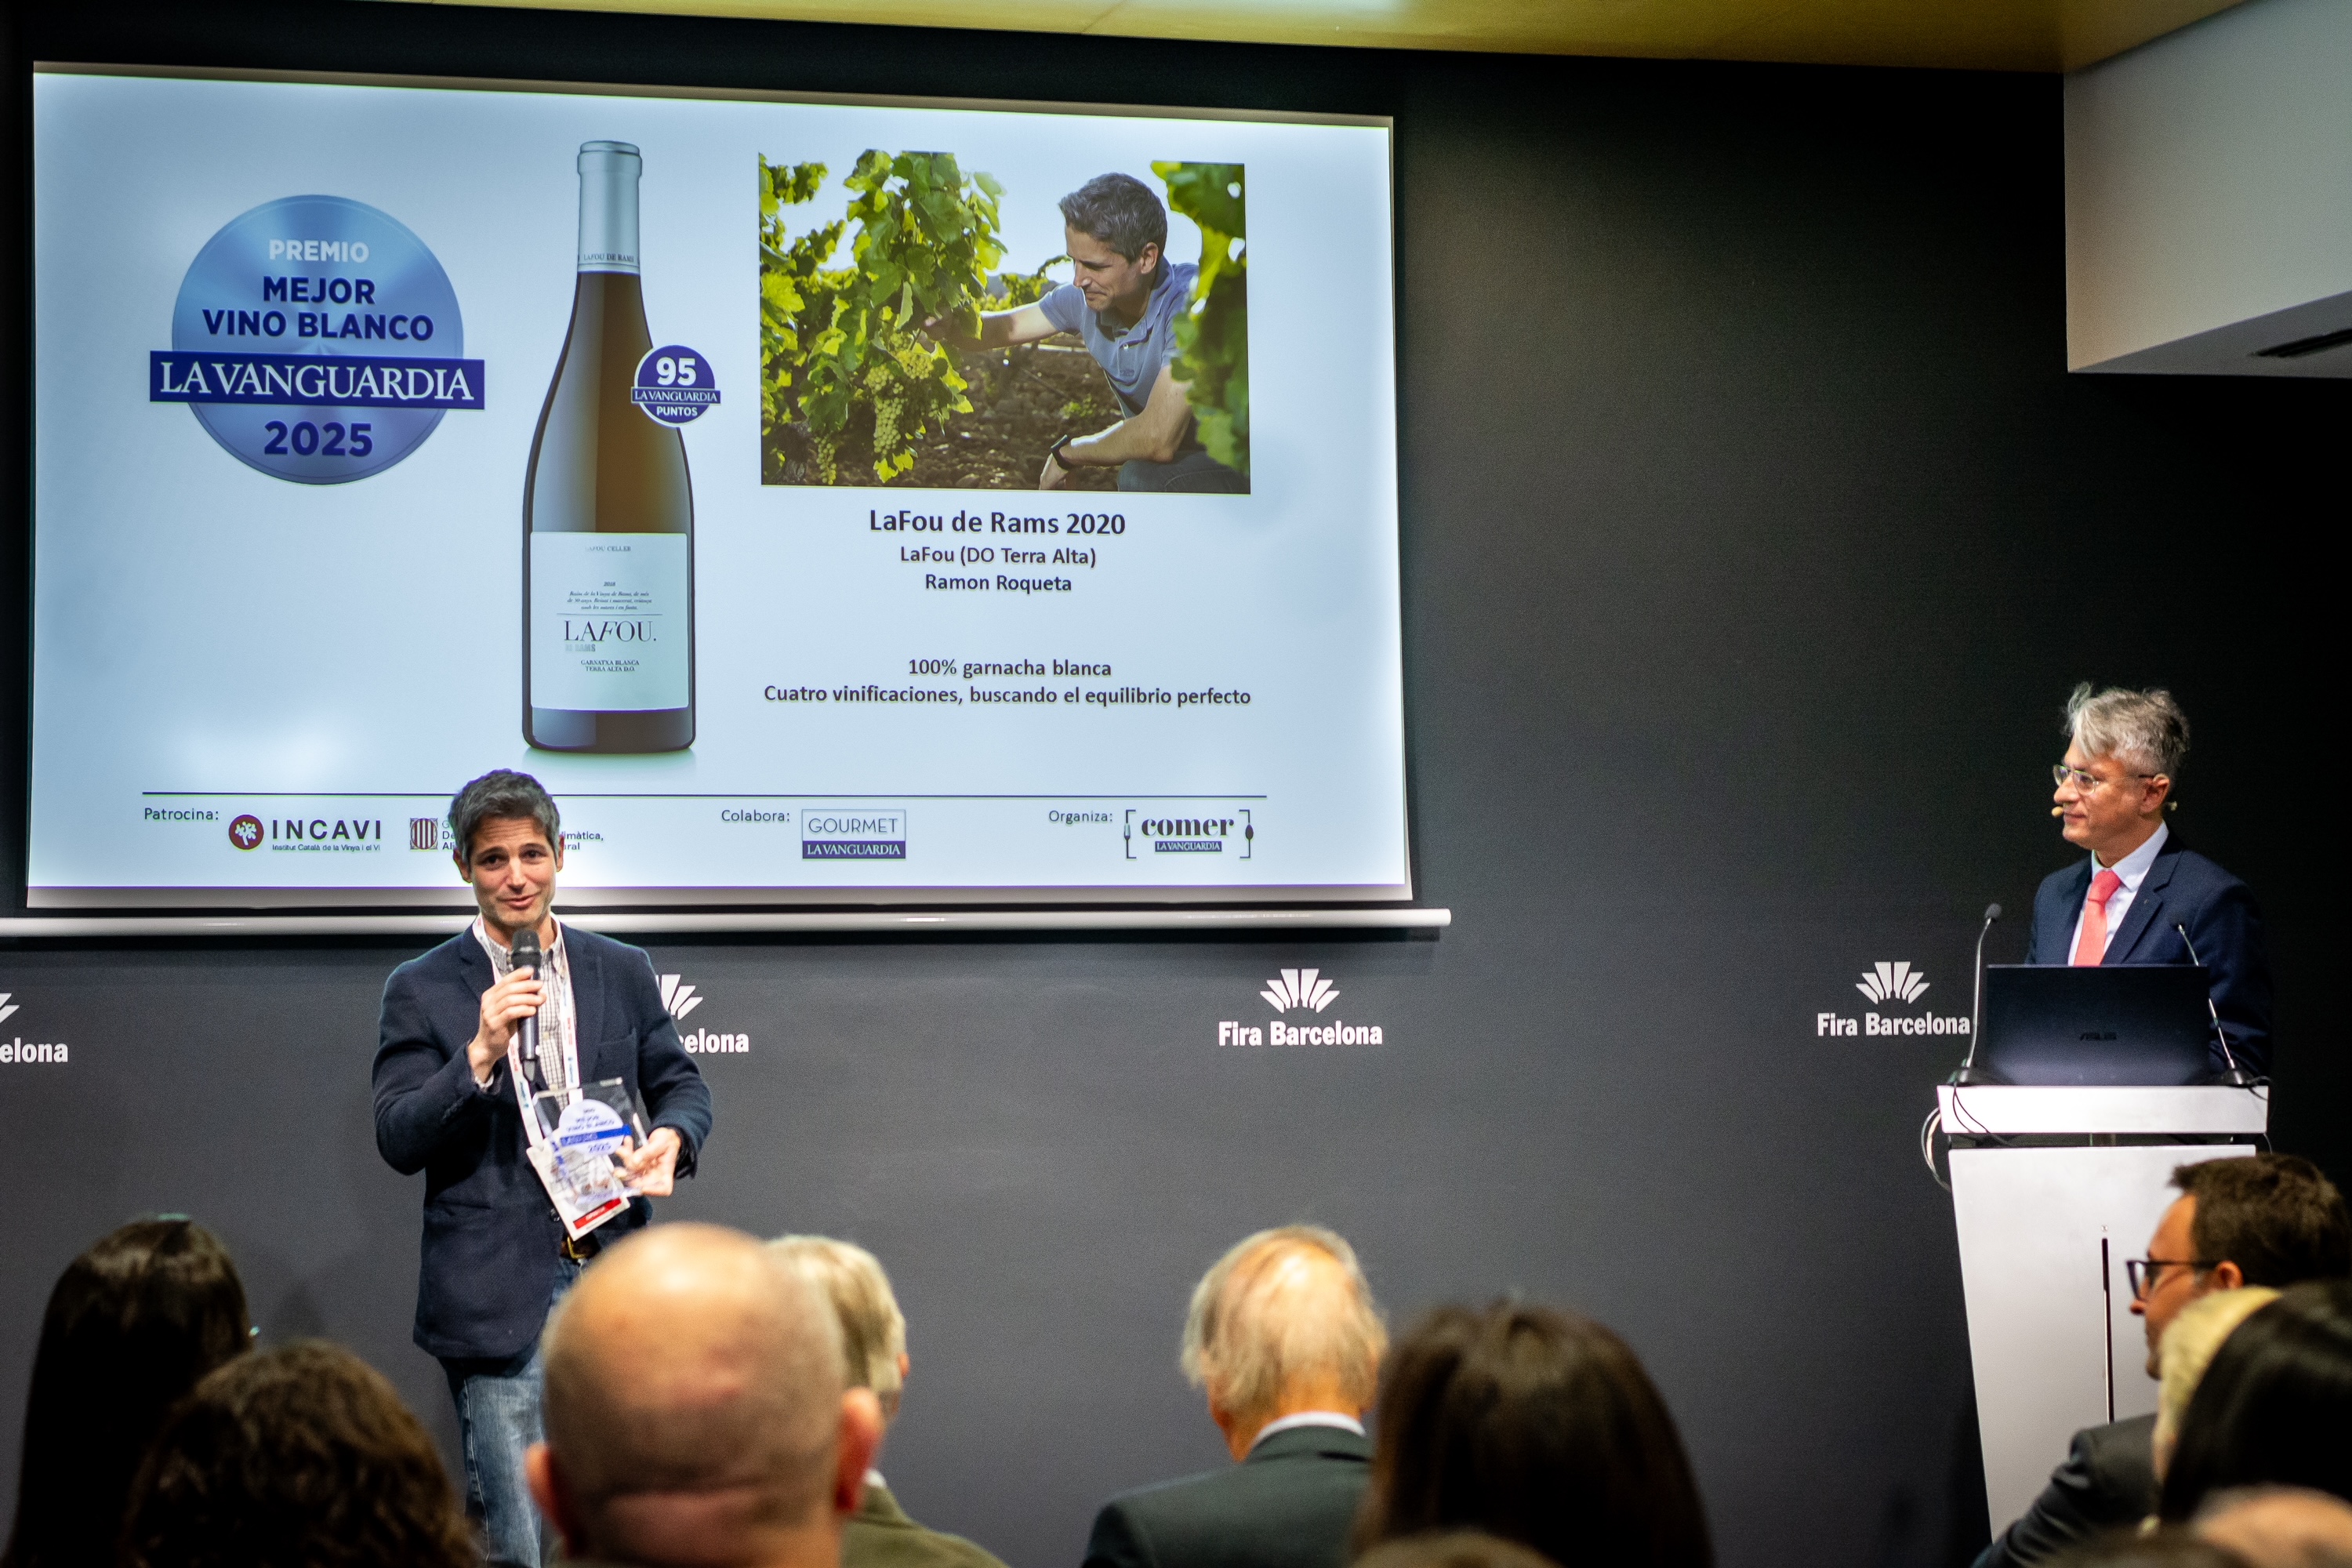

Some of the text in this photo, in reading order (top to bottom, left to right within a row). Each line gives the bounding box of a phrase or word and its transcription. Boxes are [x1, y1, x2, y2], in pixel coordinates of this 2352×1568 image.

[269, 239, 370, 263] PREMIO
[263, 276, 376, 305] MEJOR
[202, 309, 434, 341] VINO BLANCO
[656, 357, 697, 387] 95
[657, 406, 698, 416] PUNTOS
[264, 420, 373, 456] 2025
[869, 510, 1126, 535] LaFou de Rams 2020
[901, 546, 1096, 568] LaFou (DO Terra Alta)
[926, 574, 1072, 594] Ramon Roqueta
[909, 659, 1112, 679] 100% garnacha blanca
[764, 685, 1250, 707] Cuatro vinificaciones, buscando el equilibrio perfecto
[144, 808, 219, 821] Patrocina:
[721, 809, 790, 822] Colabora:
[808, 818, 898, 833] GOURMET
[1049, 810, 1113, 825] Organiza:
[273, 820, 381, 840] INCAVI
[561, 831, 604, 841] limàtica,
[1142, 818, 1234, 837] comer
[1218, 1021, 1382, 1046] Fira Barcelona
[1817, 1011, 1970, 1036] Fira Barcelona
[0, 1037, 68, 1063] elona
[679, 1028, 750, 1054] elona
